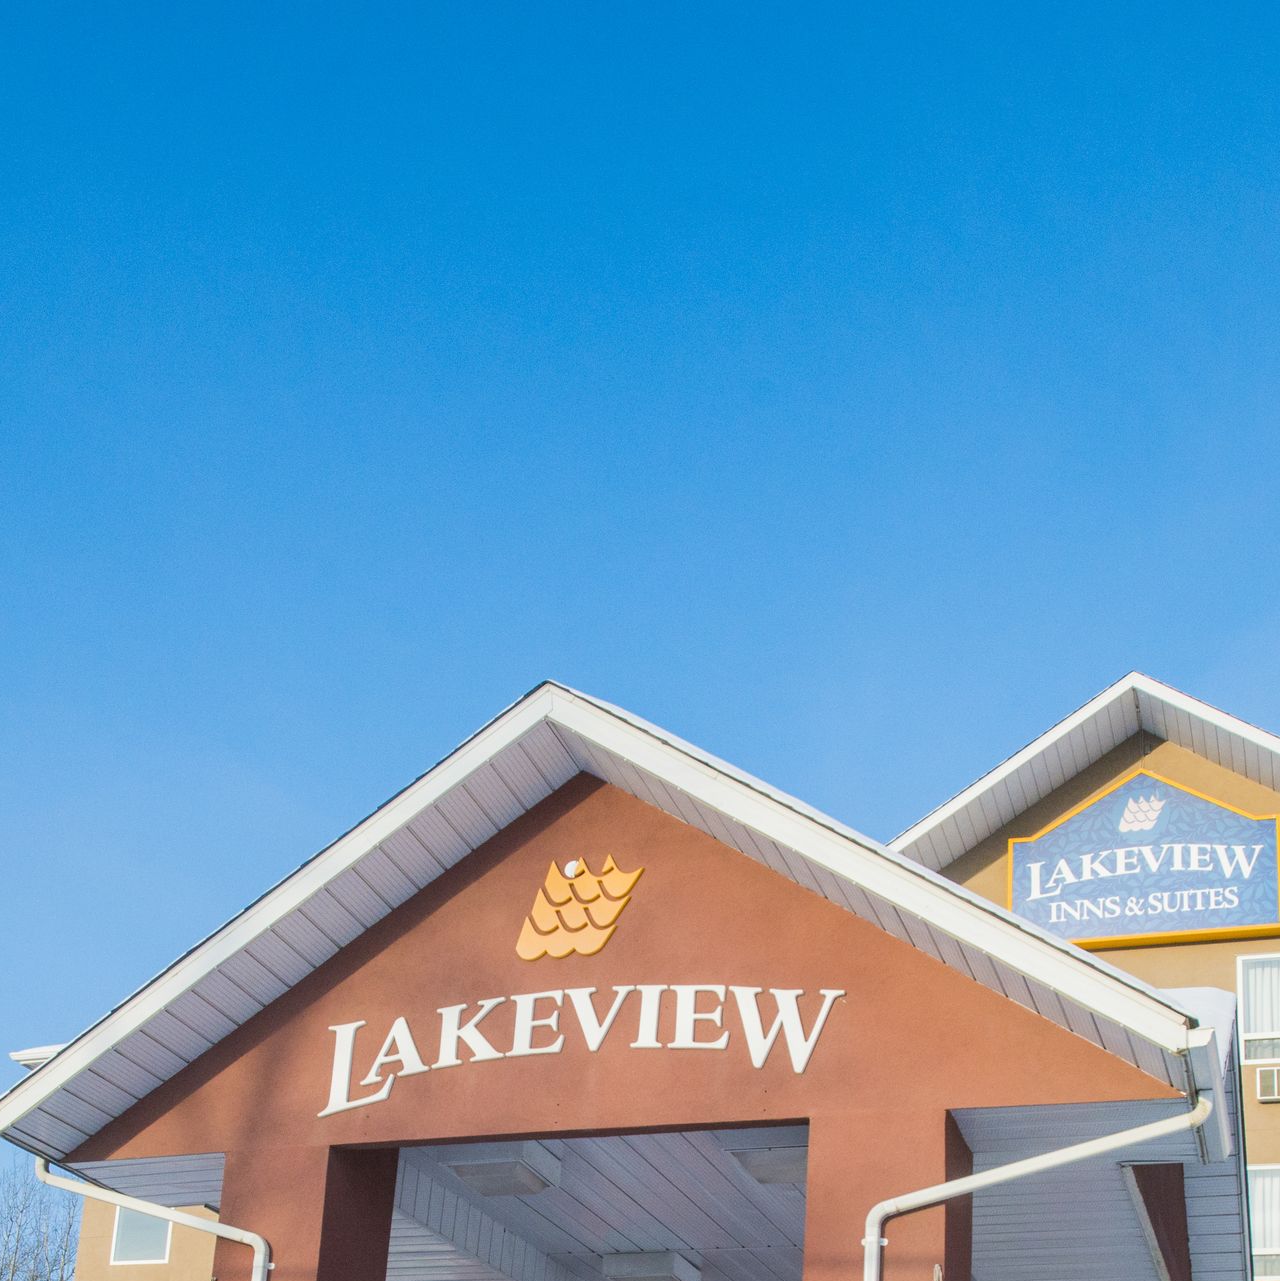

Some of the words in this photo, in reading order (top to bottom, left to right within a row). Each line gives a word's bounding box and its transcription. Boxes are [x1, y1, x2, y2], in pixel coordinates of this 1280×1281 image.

[1028, 844, 1264, 901] LAKEVIEW
[1049, 897, 1120, 923] INNS
[1125, 897, 1144, 916] &
[1147, 887, 1239, 915] SUITES
[317, 984, 845, 1117] LAKEVIEW
